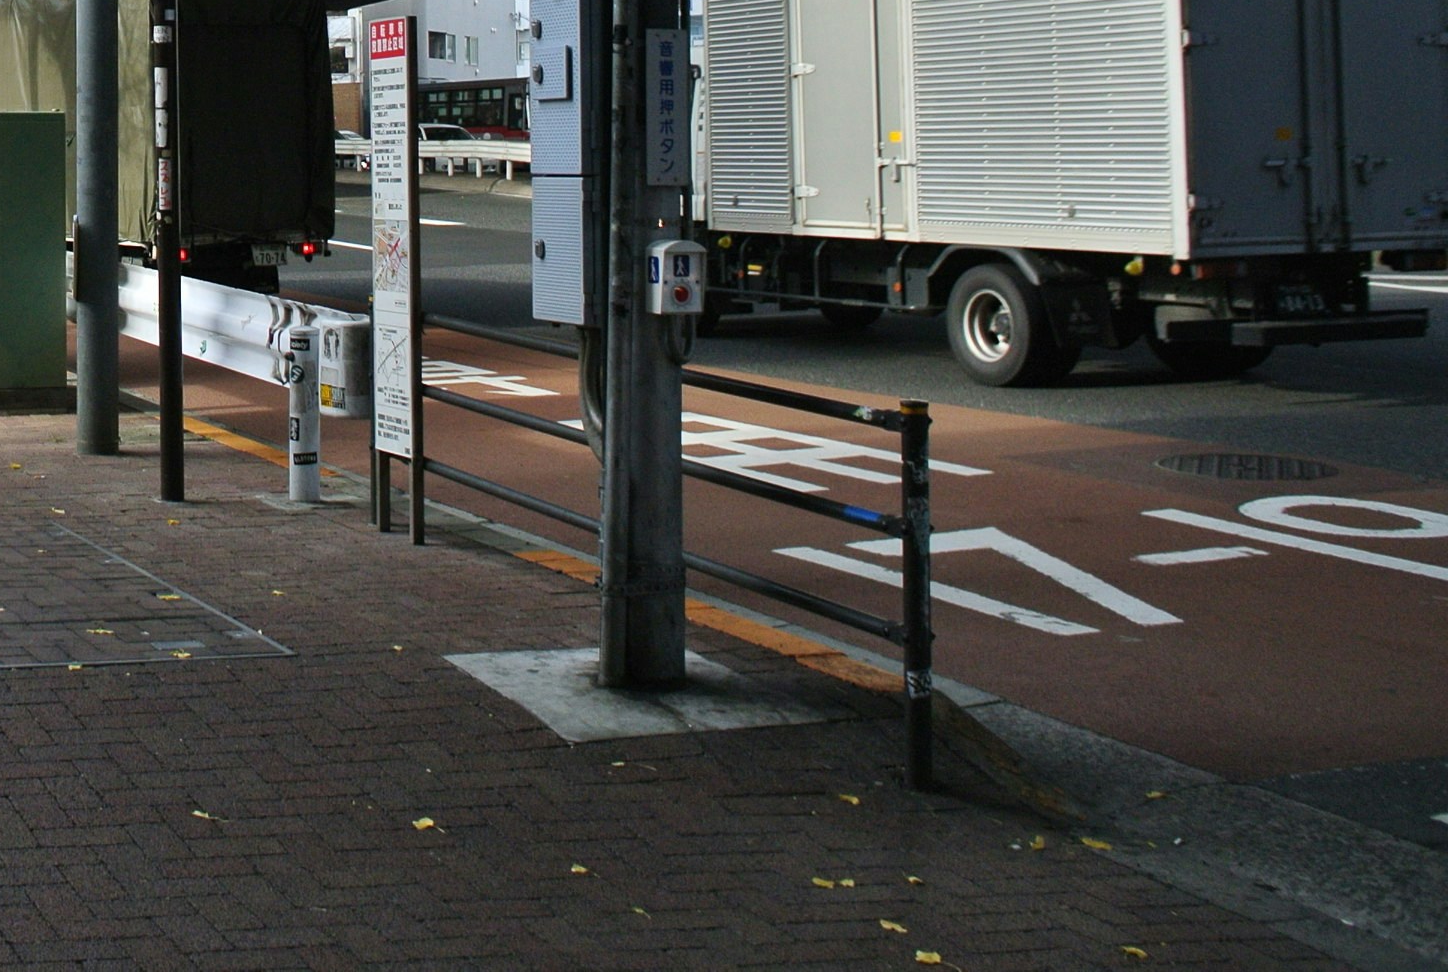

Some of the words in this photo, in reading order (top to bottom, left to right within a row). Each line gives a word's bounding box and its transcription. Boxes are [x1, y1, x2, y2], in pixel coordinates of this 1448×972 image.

[658, 39, 676, 175] 音響用押ボタン
